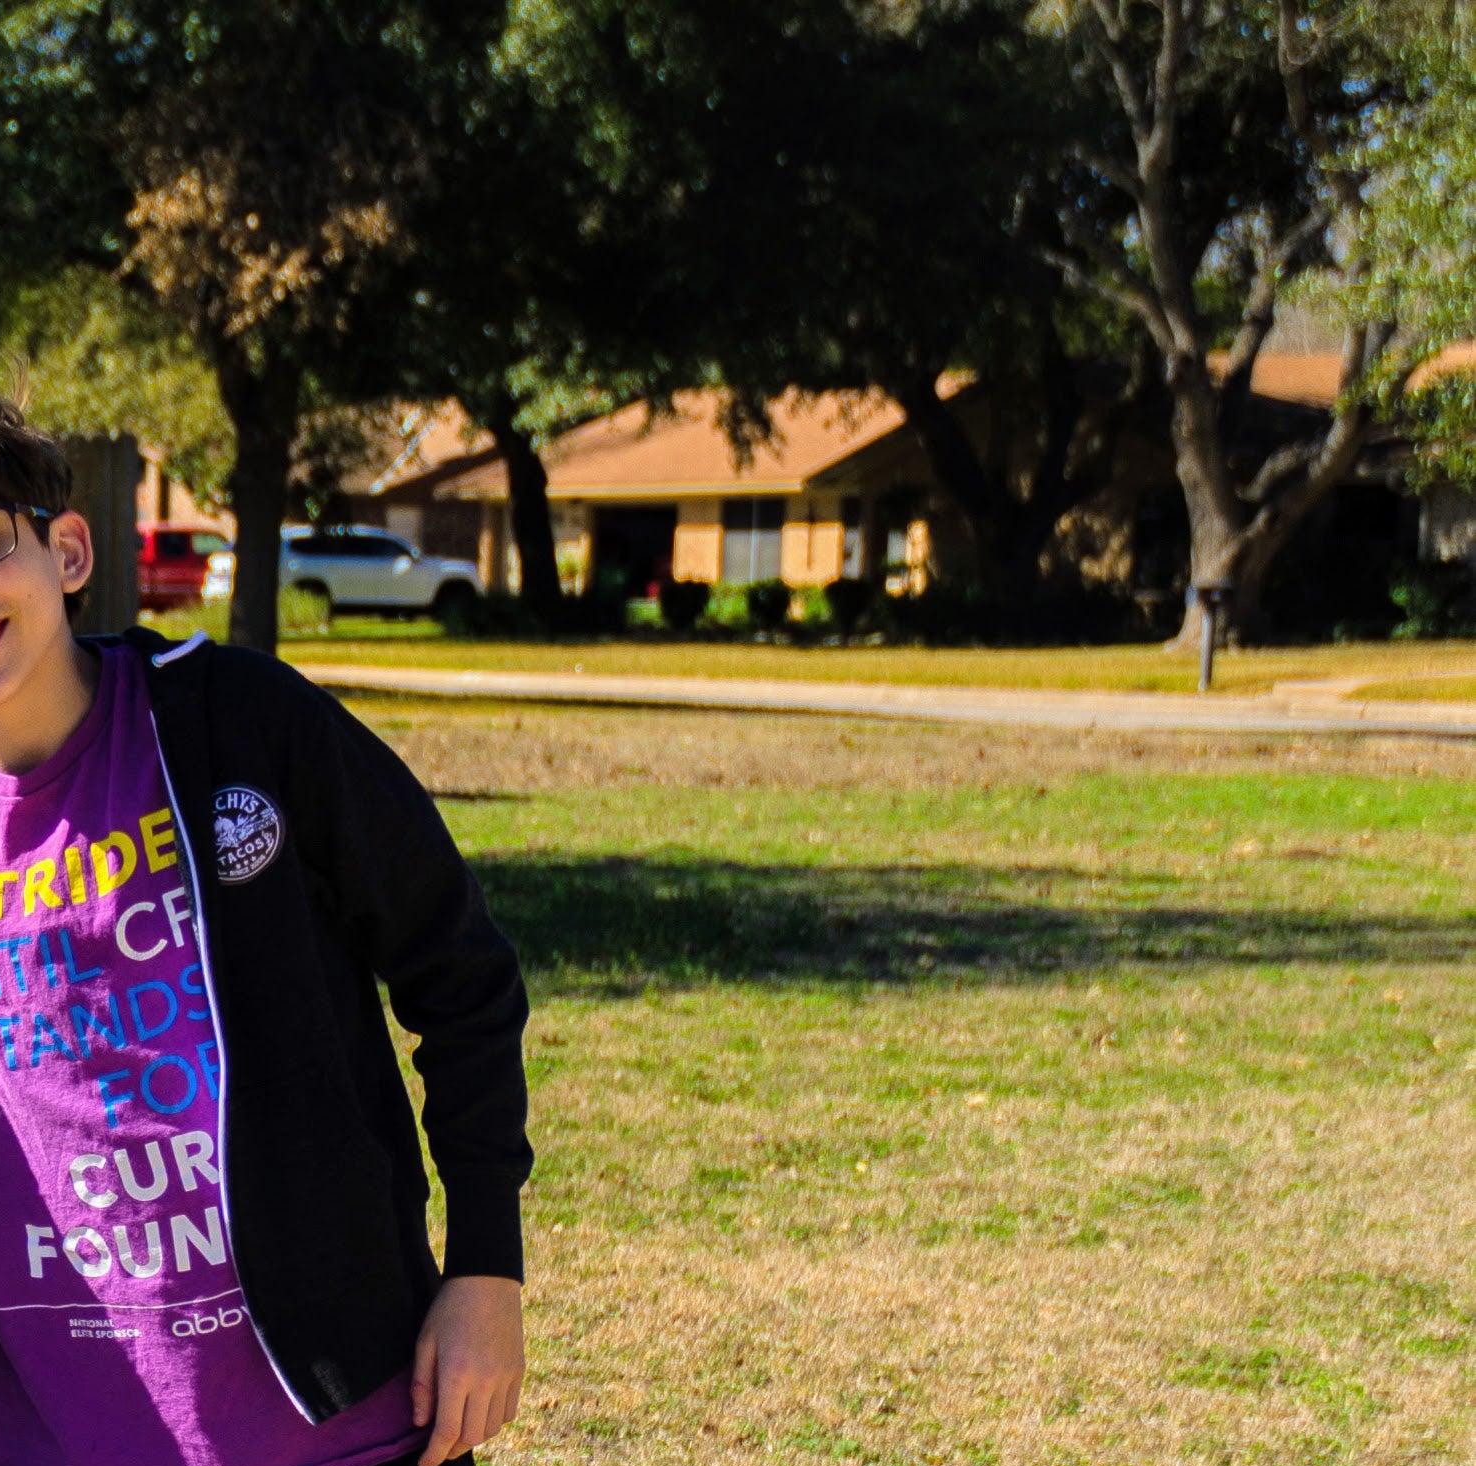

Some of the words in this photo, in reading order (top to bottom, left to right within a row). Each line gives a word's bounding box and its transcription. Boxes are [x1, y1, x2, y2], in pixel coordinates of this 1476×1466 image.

[218, 838, 265, 866] TACOS
[115, 886, 192, 962] CF
[25, 1206, 227, 1279] FOUN
[171, 1305, 250, 1337] abb
